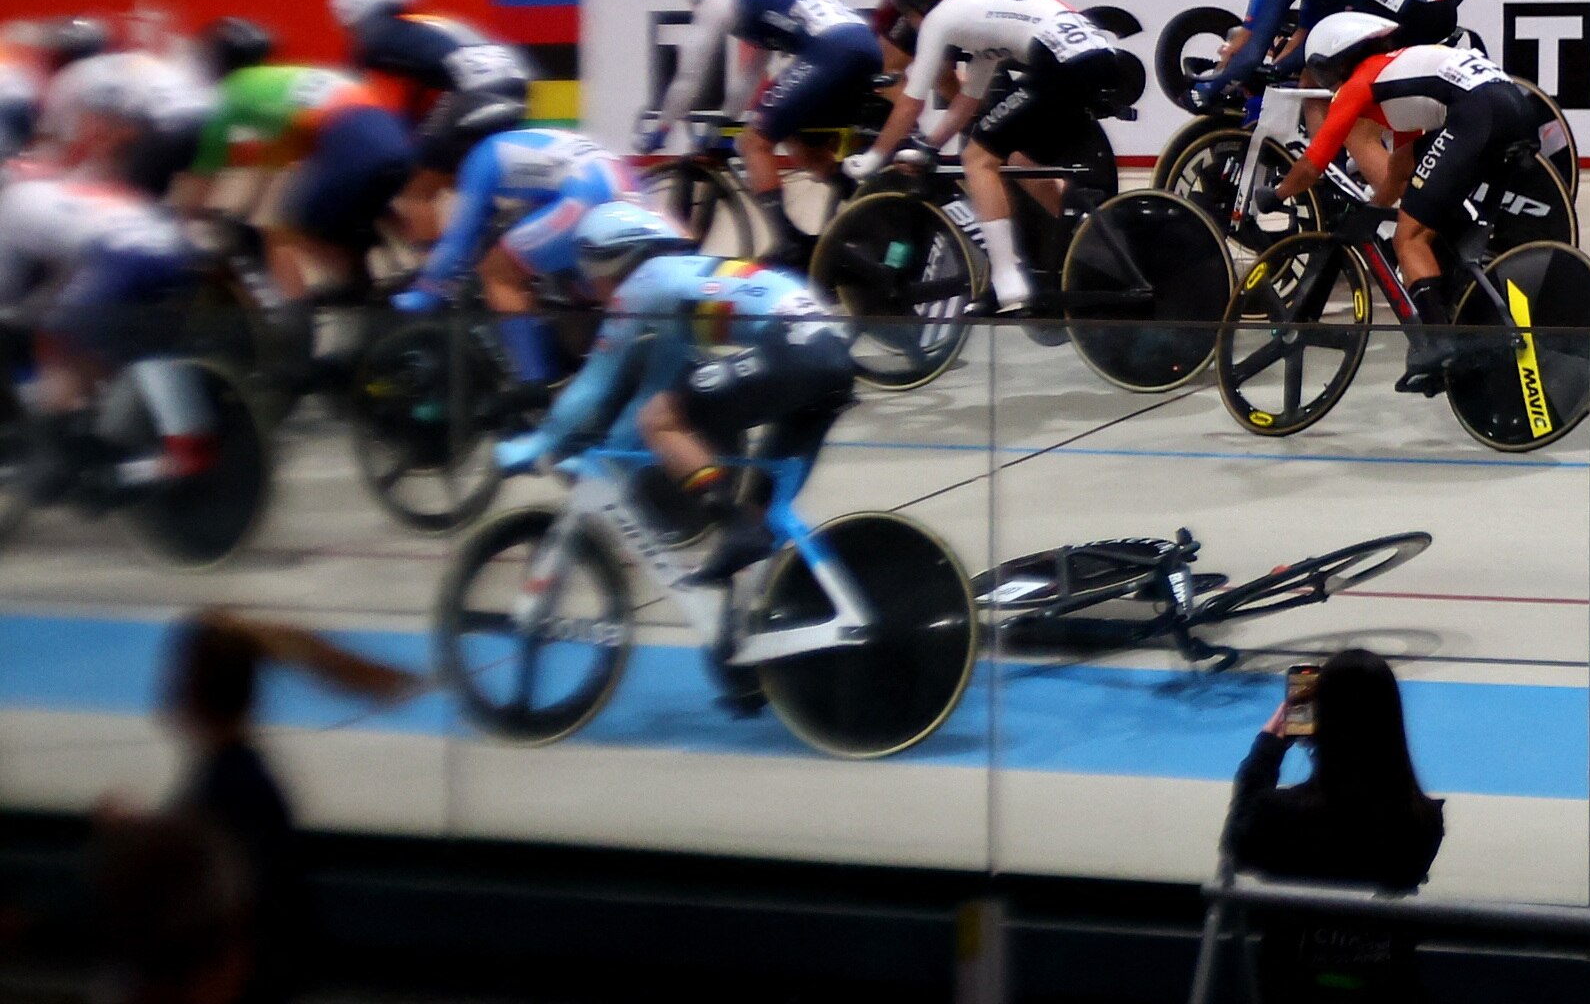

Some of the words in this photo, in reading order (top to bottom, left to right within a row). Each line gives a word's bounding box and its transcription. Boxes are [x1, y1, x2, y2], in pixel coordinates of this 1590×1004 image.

[1057, 21, 1088, 45] 40
[1416, 128, 1455, 180] EGYPT
[1522, 367, 1548, 429] MAVIC
